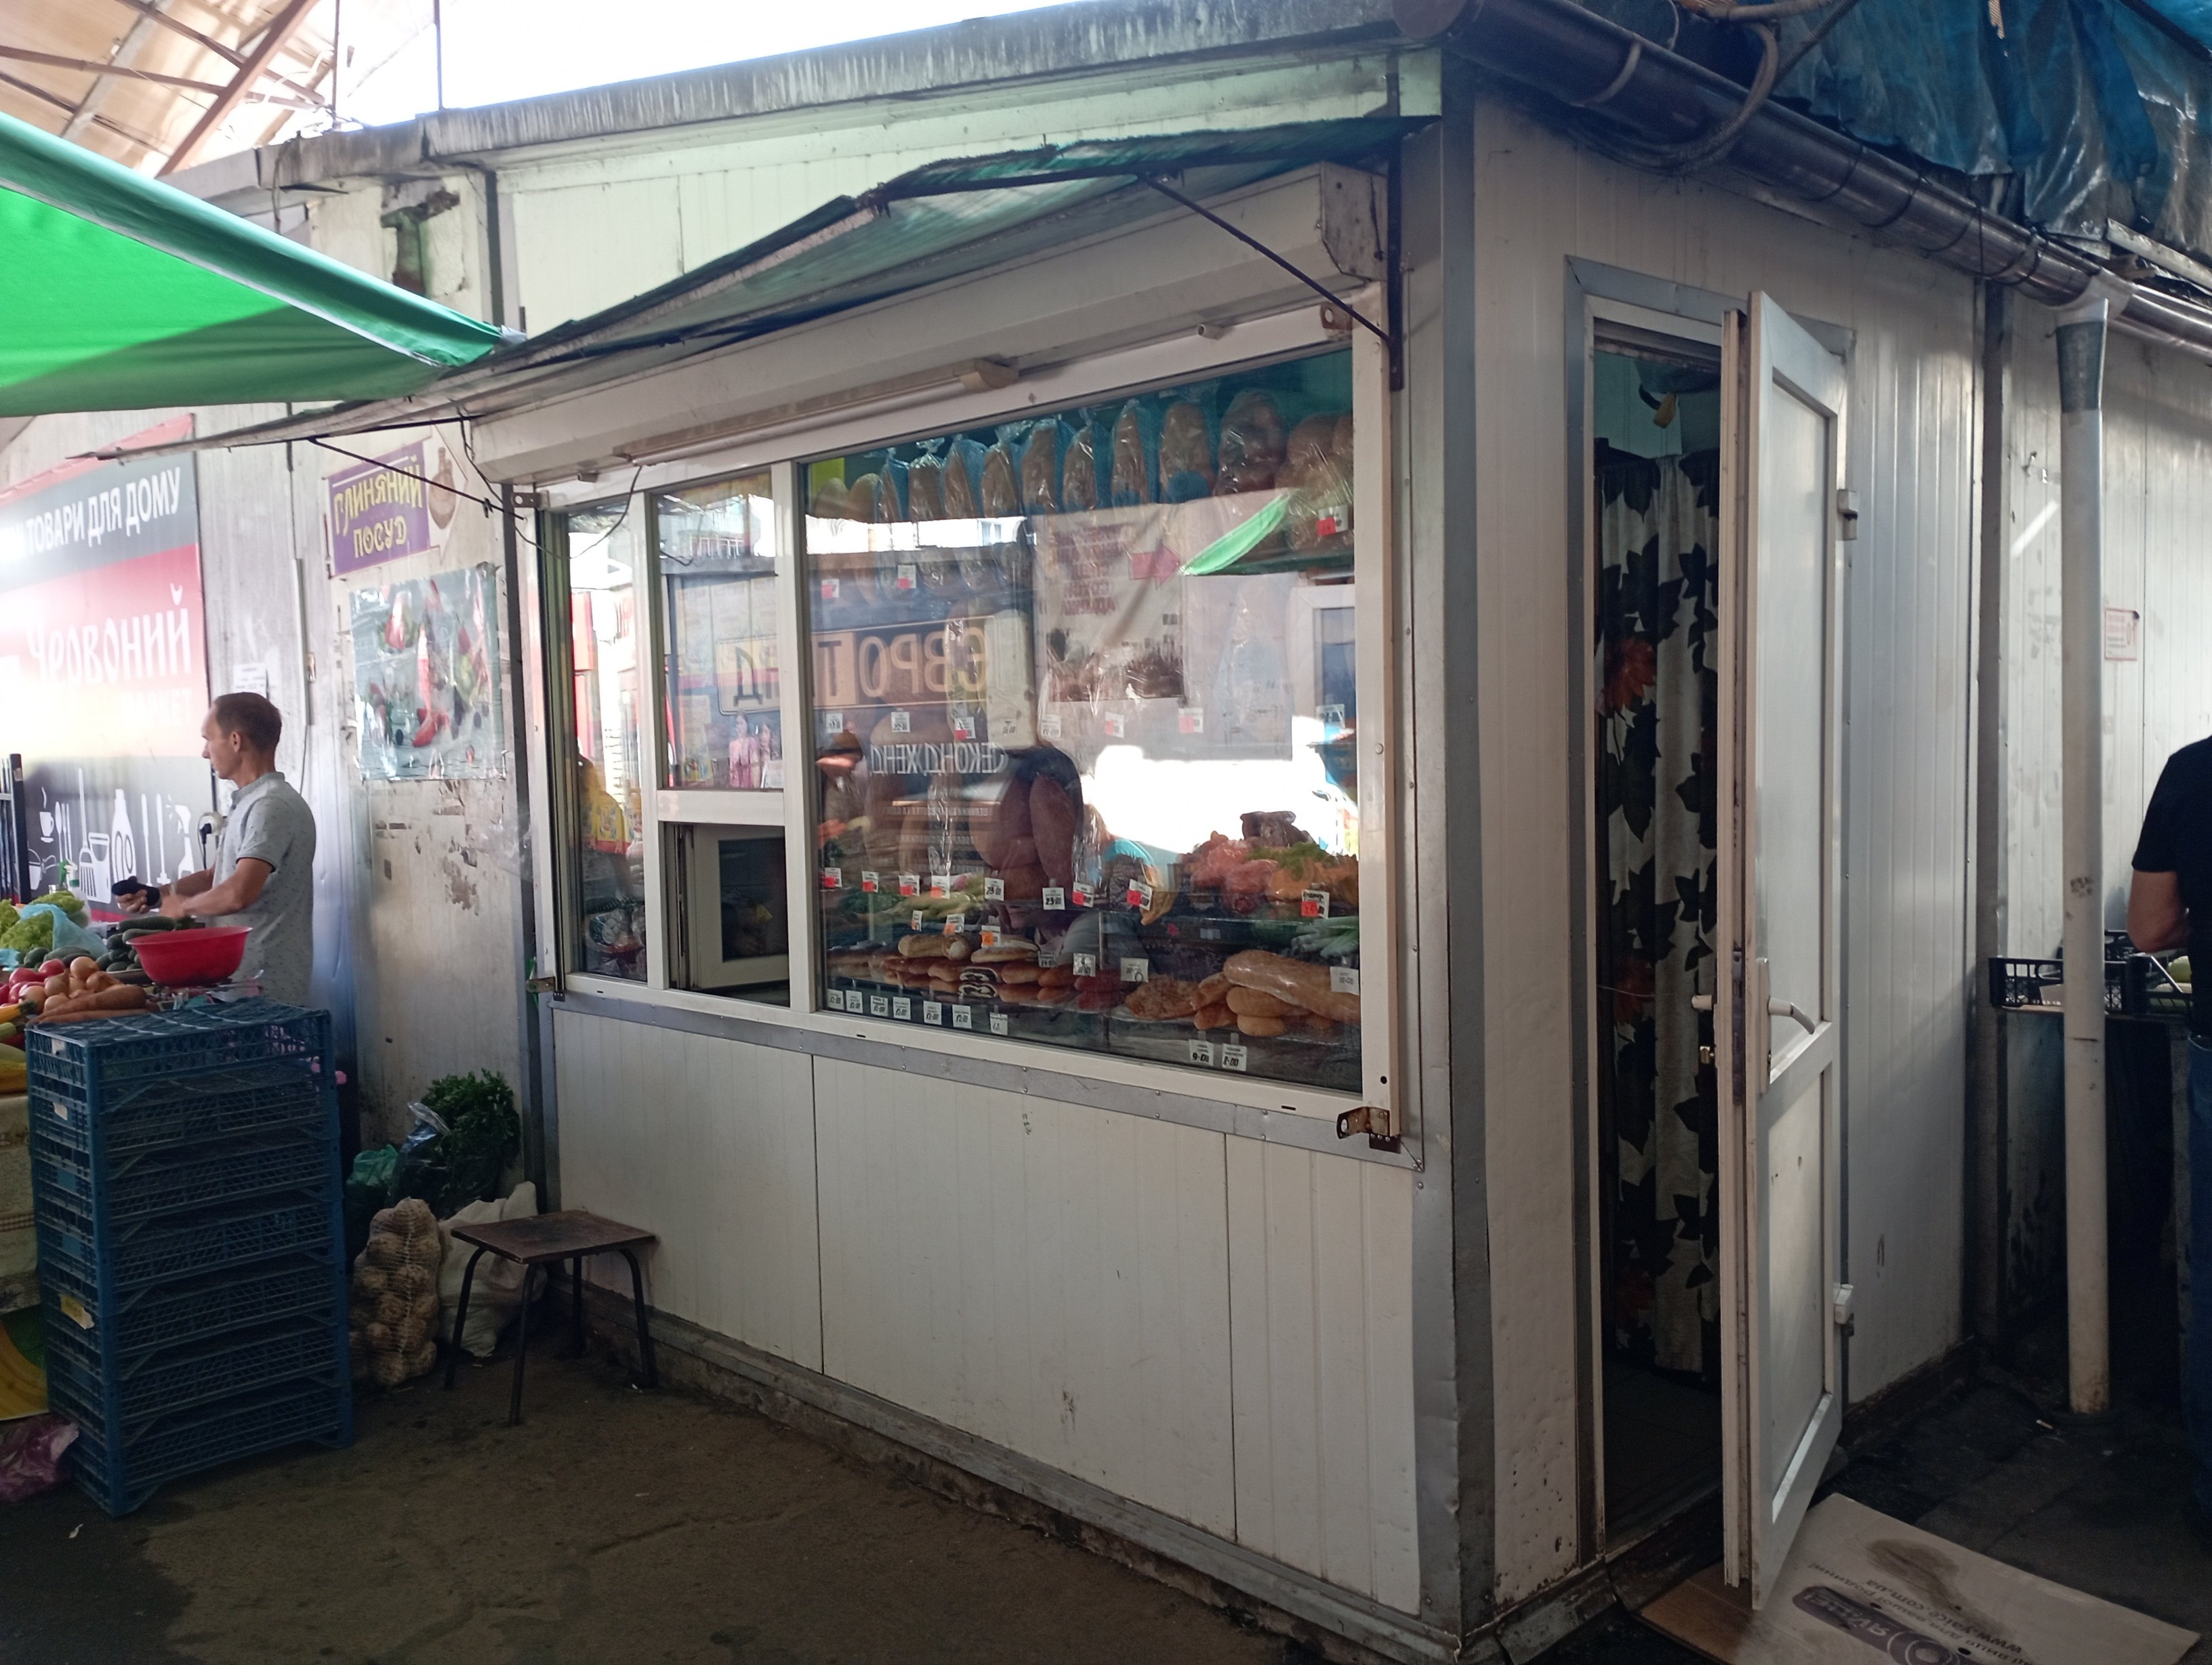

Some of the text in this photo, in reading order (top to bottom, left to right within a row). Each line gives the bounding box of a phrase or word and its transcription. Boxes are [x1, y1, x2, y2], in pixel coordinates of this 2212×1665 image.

[26, 501, 85, 556] ТОВАРИ
[88, 487, 123, 548] ДЛЯ
[126, 467, 180, 537] ДОМУ
[334, 455, 422, 537] ГЛИНЯНИЙ
[353, 515, 407, 558] ПОСУД
